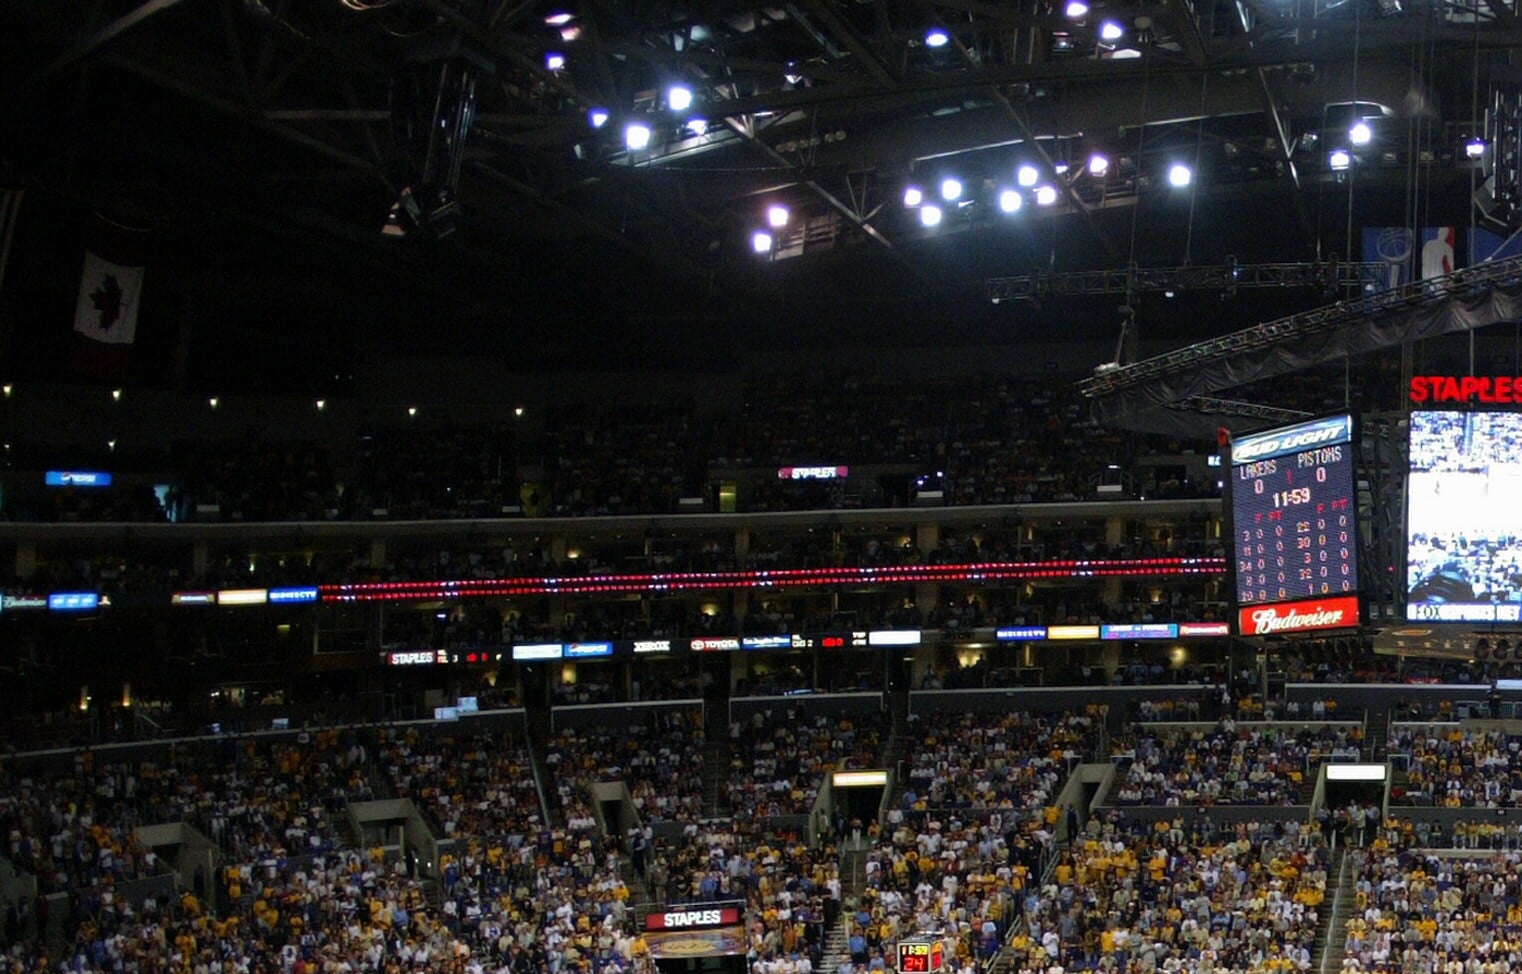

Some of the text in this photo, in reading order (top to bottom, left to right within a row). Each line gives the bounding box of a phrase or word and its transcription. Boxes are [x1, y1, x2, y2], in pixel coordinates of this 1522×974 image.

[1241, 424, 1344, 458] BUD LIGHT
[1240, 446, 1342, 480] LAKERS PISTONS
[1255, 480, 1264, 494] 0
[1316, 468, 1326, 482] 0
[1272, 488, 1311, 508] 11:59
[1252, 606, 1343, 634] Budweiser
[634, 640, 670, 652] XEROX
[704, 638, 740, 649] TOYOTA
[391, 651, 433, 665] STAPLES
[664, 909, 721, 927] STAPLES
[904, 957, 924, 971] 24
